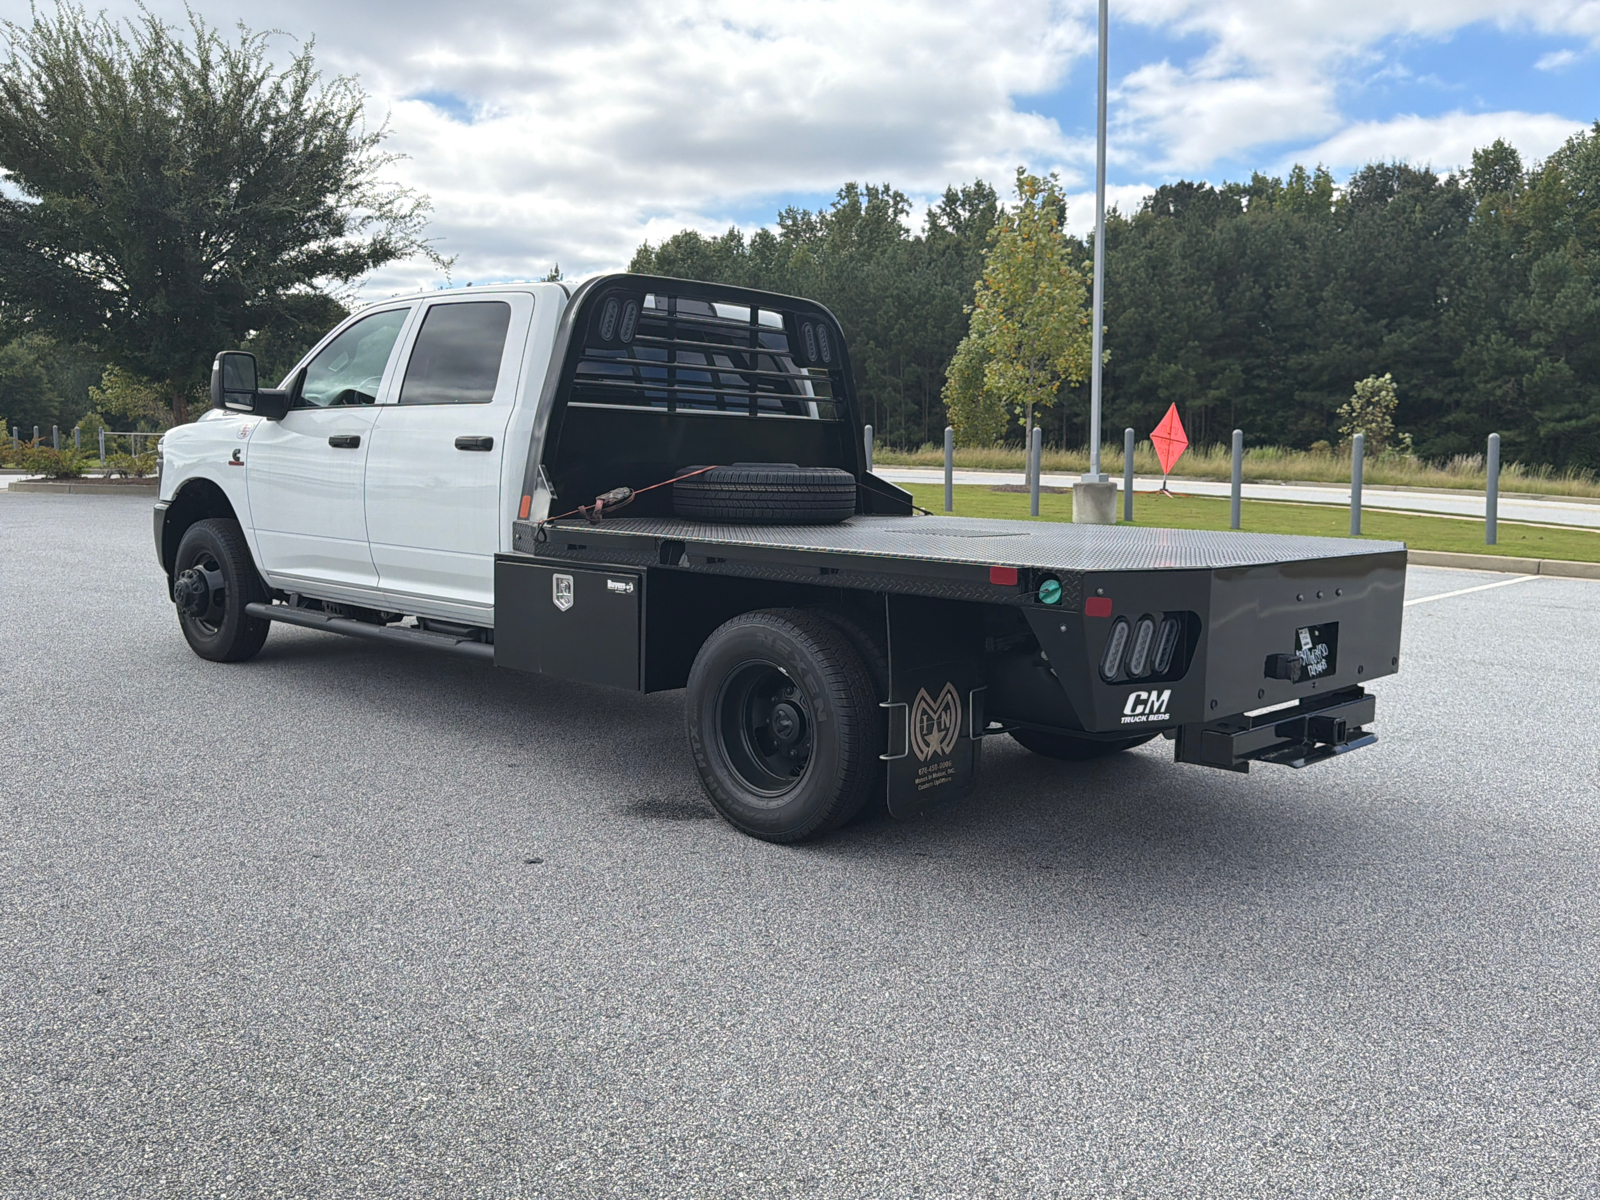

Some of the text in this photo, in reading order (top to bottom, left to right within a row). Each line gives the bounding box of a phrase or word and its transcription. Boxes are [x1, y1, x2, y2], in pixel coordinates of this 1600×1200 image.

[757, 632, 828, 722] NEXEN
[1123, 689, 1172, 715] CM
[1120, 713, 1170, 724] TRUCK BEDS
